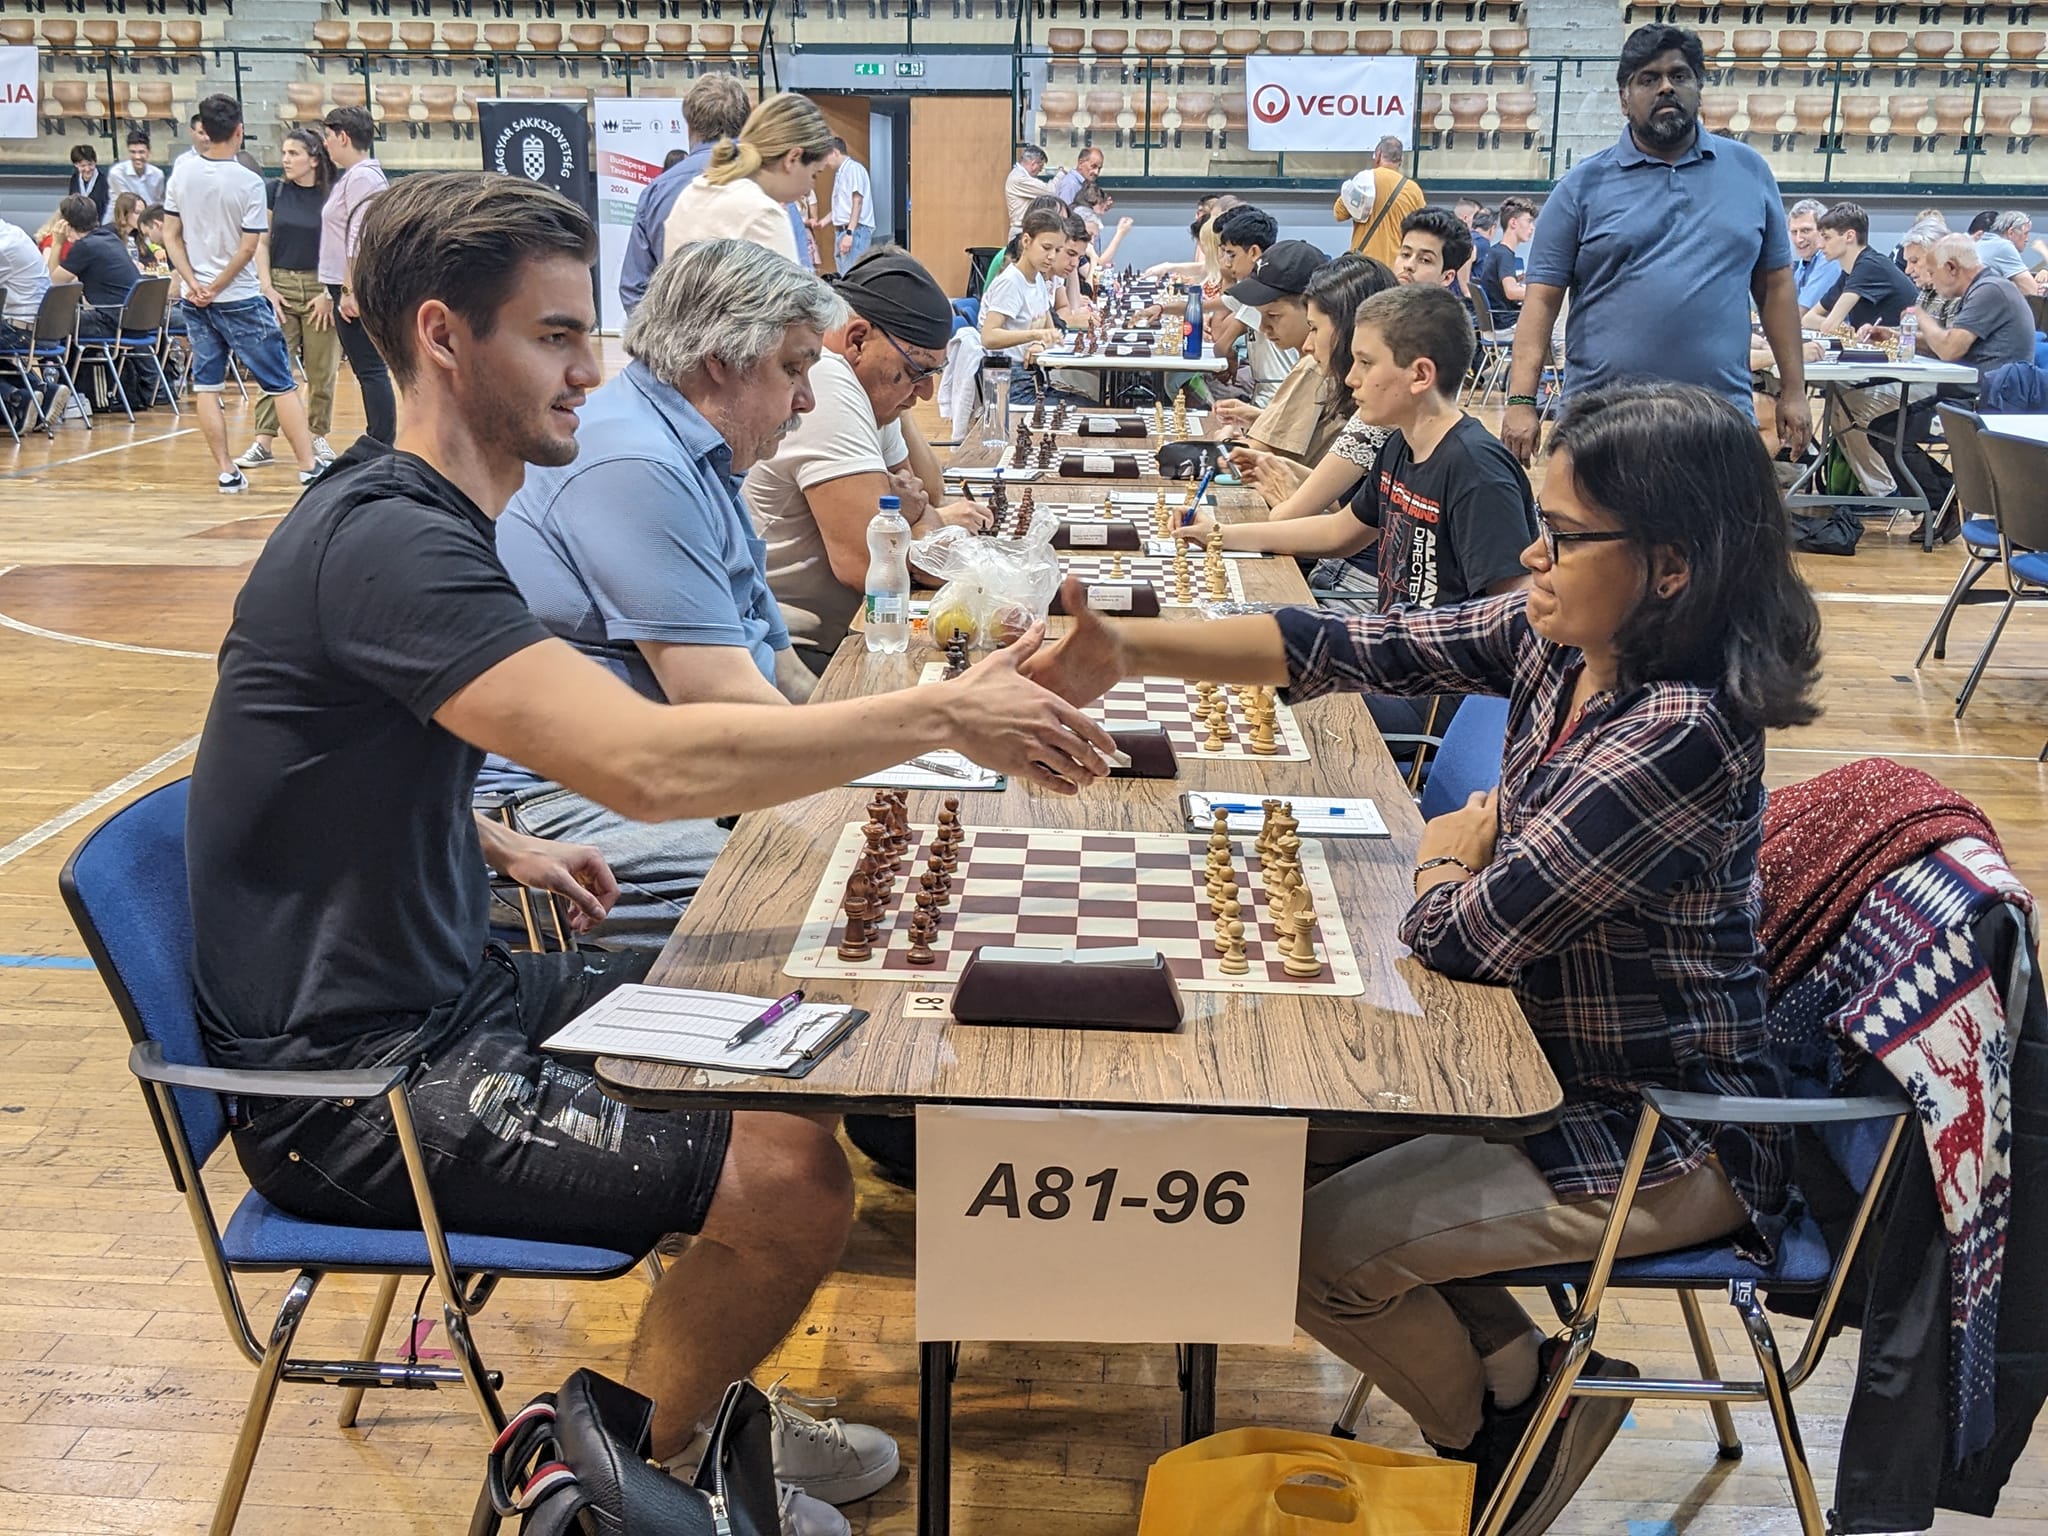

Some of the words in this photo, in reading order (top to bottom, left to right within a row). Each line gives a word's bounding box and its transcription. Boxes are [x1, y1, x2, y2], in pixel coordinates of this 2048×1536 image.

[1296, 94, 1405, 117] VEOLIA
[495, 128, 514, 176] MAGYAR
[609, 155, 647, 173] Budapesti
[609, 166, 637, 179] Tavaszi
[610, 184, 629, 194] 2024
[1409, 526, 1426, 605] DIRECTED
[913, 997, 945, 1011] 81
[965, 1162, 1250, 1225] A81-96
